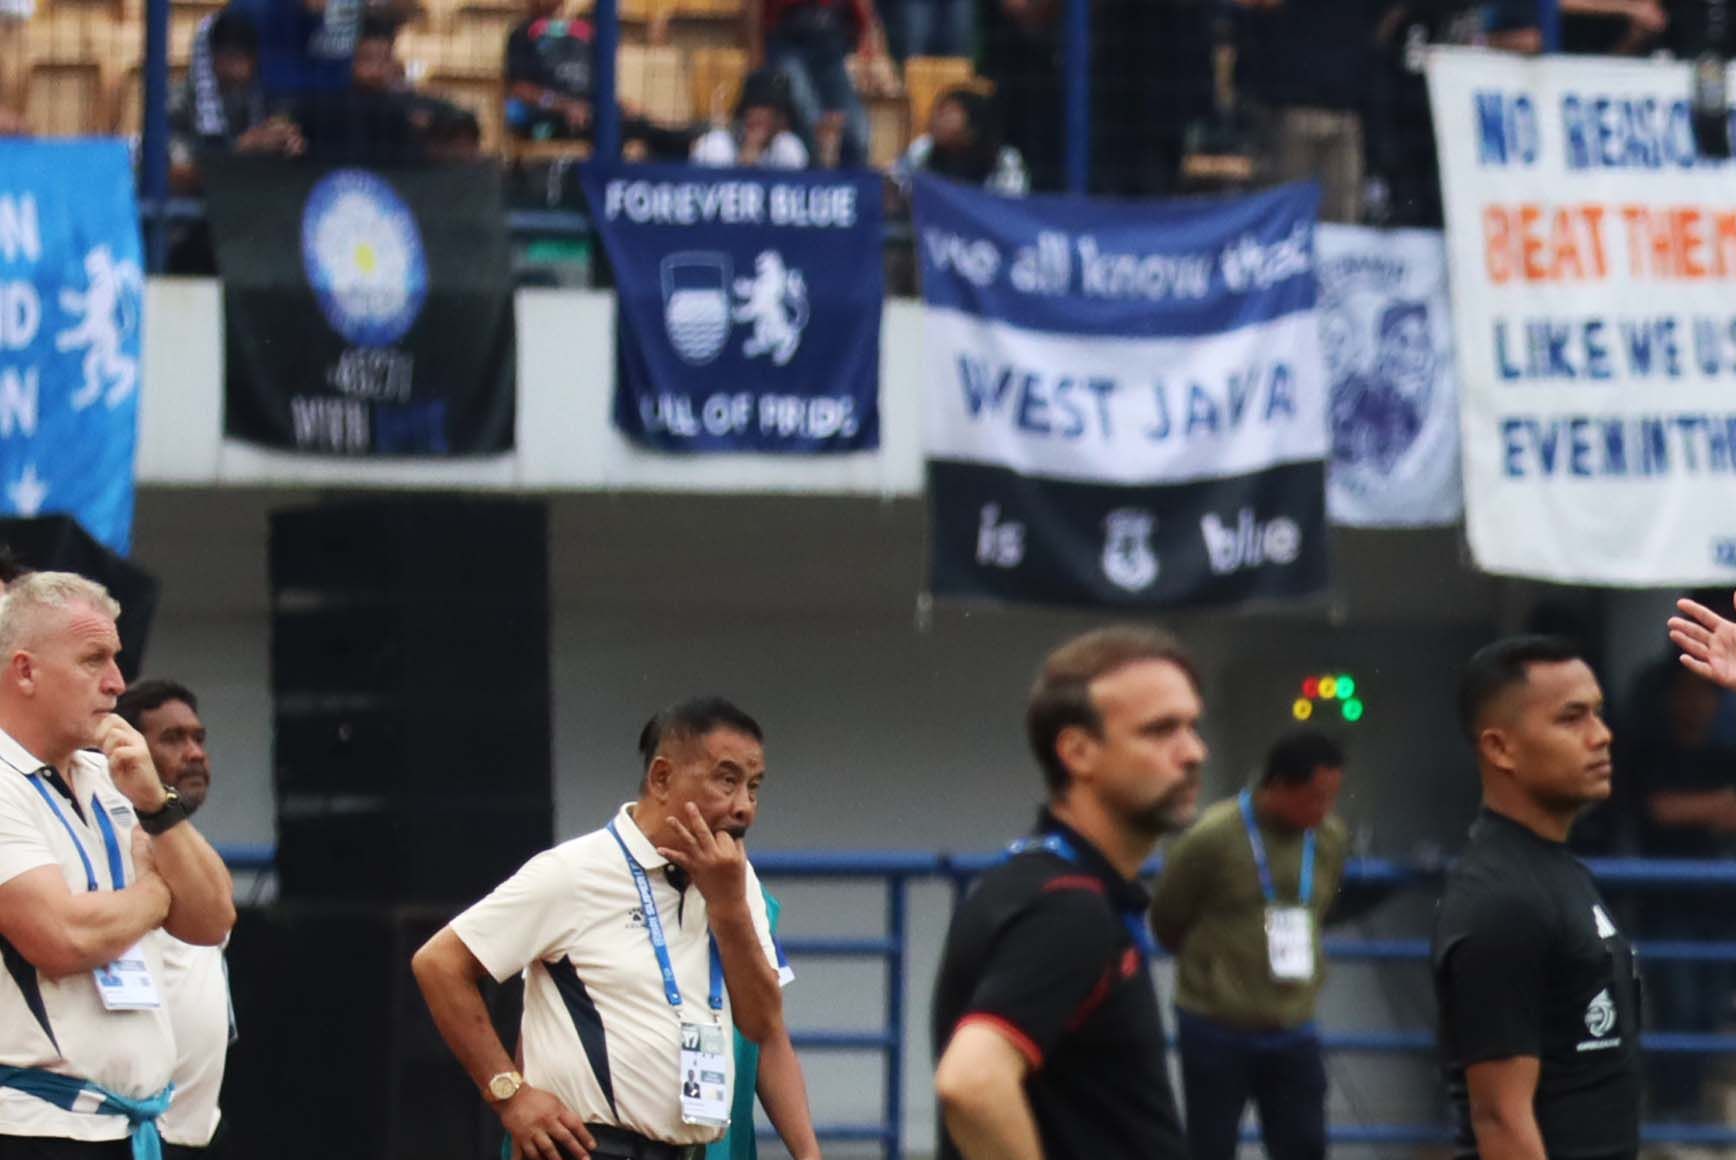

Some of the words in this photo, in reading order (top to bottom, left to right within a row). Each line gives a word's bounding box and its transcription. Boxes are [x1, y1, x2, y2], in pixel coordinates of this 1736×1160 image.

[1474, 90, 1539, 166] NO
[1562, 95, 1726, 169] REASO
[605, 180, 765, 225] FOREVER
[770, 184, 857, 227] BLUE
[1010, 231, 1071, 295] all
[1080, 236, 1212, 299] know
[1484, 204, 1607, 284] BEAT
[1493, 317, 1611, 380] LIKE
[1620, 317, 1681, 377] WE
[702, 393, 751, 436] OF
[957, 354, 1117, 444] WEST
[1146, 362, 1293, 440] JAVA
[1497, 416, 1627, 476] EVEN
[977, 504, 1026, 568] is
[1201, 509, 1301, 574] blue
